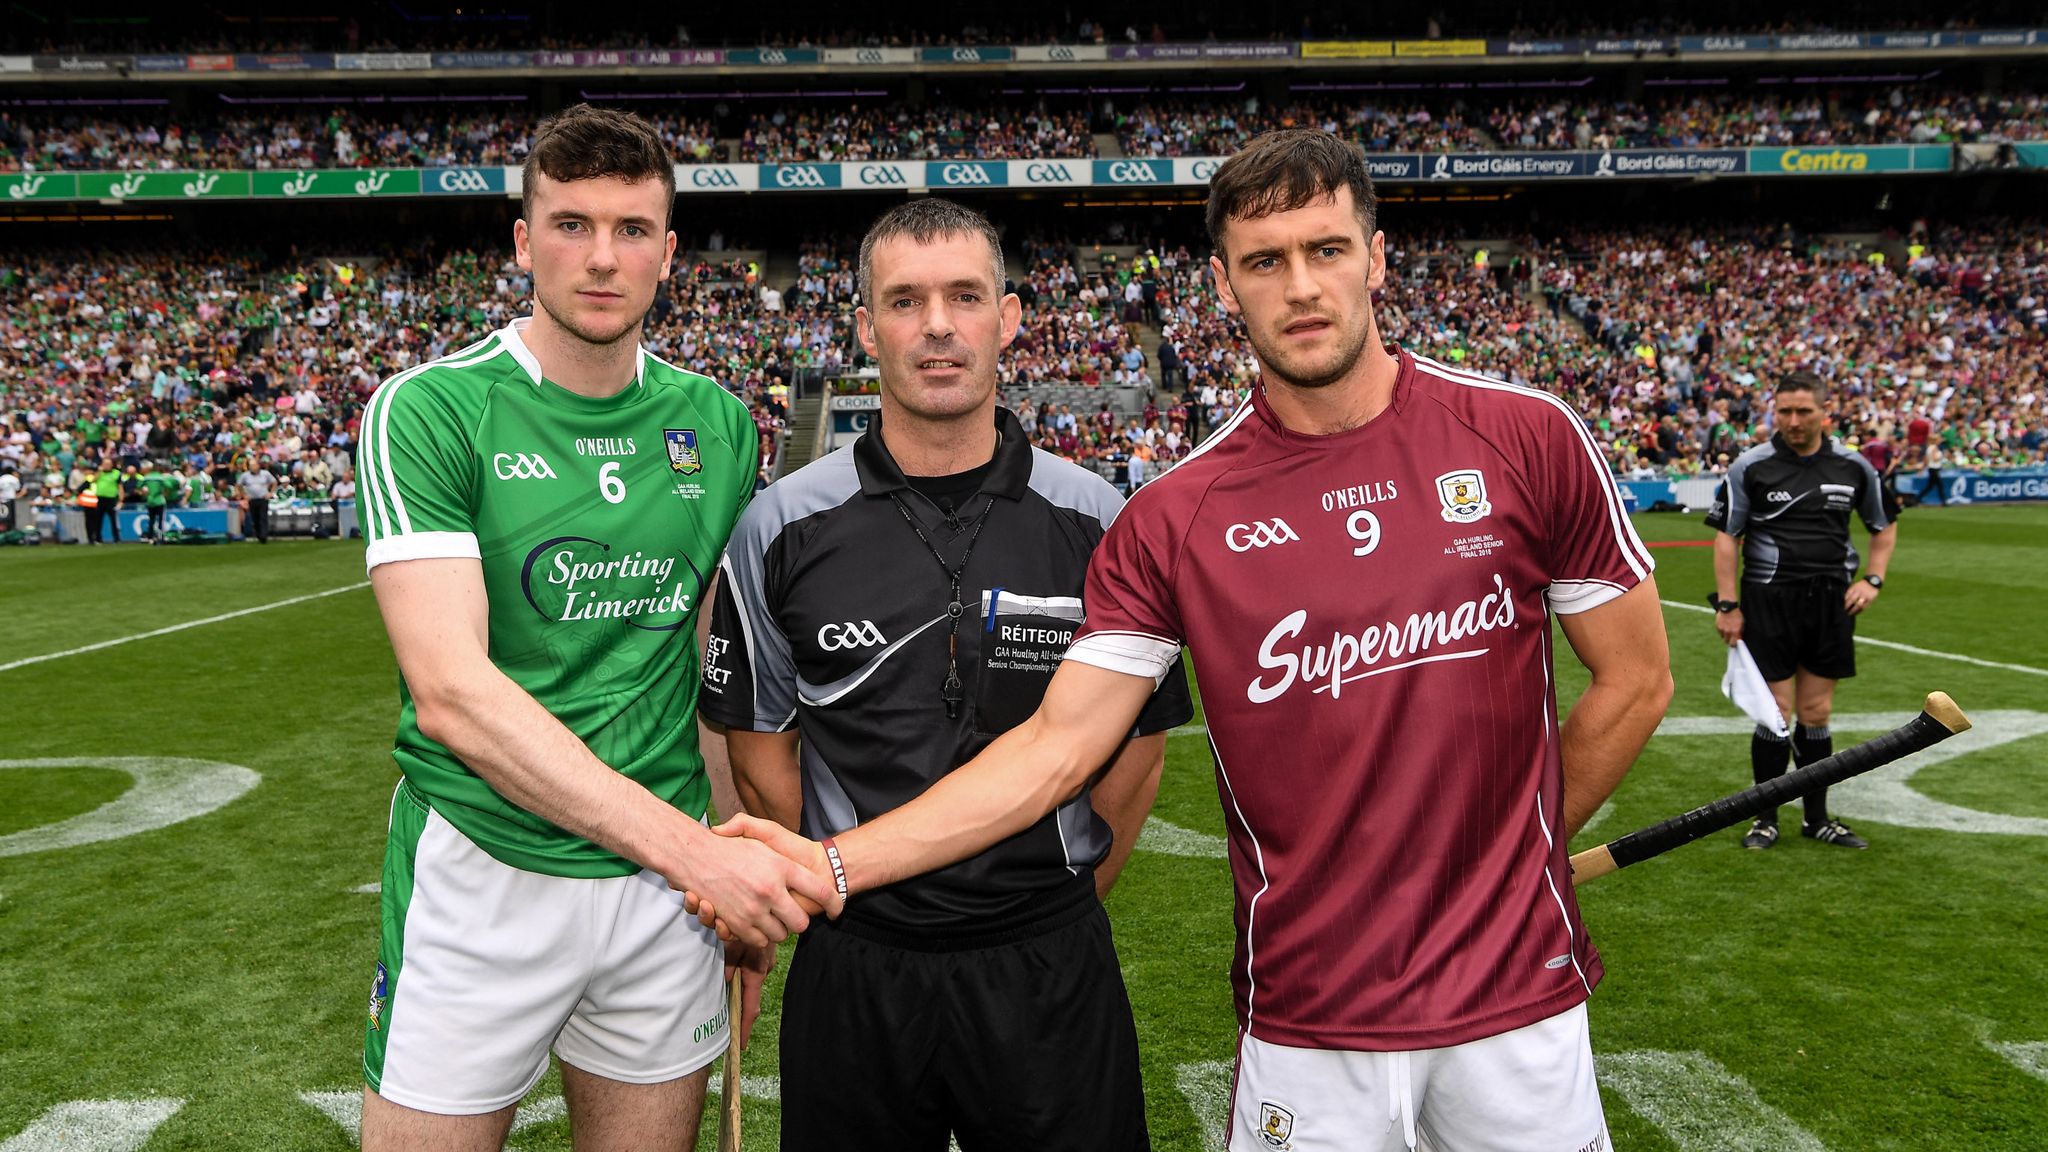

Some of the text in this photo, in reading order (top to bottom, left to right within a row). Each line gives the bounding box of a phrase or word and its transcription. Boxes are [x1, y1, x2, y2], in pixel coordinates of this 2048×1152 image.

[553, 53, 574, 65] AIB
[598, 53, 619, 64] AIB
[650, 53, 671, 64] AIB
[694, 52, 715, 64] AIB
[759, 49, 787, 61] GAA
[857, 48, 885, 61] GAA
[952, 48, 980, 60] GAA
[1049, 46, 1075, 58] GAA
[1153, 48, 1178, 57] CROKE
[1180, 48, 1198, 56] PARK
[1206, 47, 1246, 56] MEETINGS
[1255, 46, 1288, 55] EVENTS
[1453, 157, 1574, 174] Bord Gáis Energy
[1616, 154, 1738, 171] Bord Gáis Energy
[1781, 150, 1868, 171] Centra
[439, 170, 490, 191] GAA
[693, 168, 739, 187] GAA
[776, 167, 826, 187] GAA
[860, 166, 907, 184] GAA
[943, 164, 990, 184] GAA
[1026, 163, 1072, 182] GAA
[1109, 162, 1158, 182] GAA
[9, 173, 46, 199] eir
[109, 173, 146, 199] eir
[183, 172, 220, 197] eir
[282, 171, 318, 196] eir
[355, 170, 390, 195] eir
[837, 397, 875, 408] CROKE
[575, 437, 637, 456] O'NEILLS
[493, 453, 558, 480] GAA
[598, 461, 628, 504] 6
[1974, 479, 2022, 497] Bord
[1321, 479, 1398, 512] O'NEILLS
[1766, 491, 1793, 503] GAA
[1225, 517, 1301, 553] GAA
[1346, 509, 1382, 557] 9
[1453, 534, 1493, 546] GAA HURLING
[1444, 539, 1504, 555] ALL IRELAND SENIOR
[1460, 551, 1478, 559] FINAL
[547, 550, 675, 590] Sporting
[558, 582, 691, 621] Limerick
[817, 620, 888, 652] GAA
[1001, 623, 1073, 645] RÉITEOIR
[1247, 573, 1515, 704] Supermac's
[709, 634, 730, 654] ECT
[706, 649, 720, 665] ET
[995, 646, 1010, 657] GAA
[1012, 647, 1039, 662] Hurling
[987, 659, 1008, 669] Senior
[1009, 660, 1050, 673] Championship
